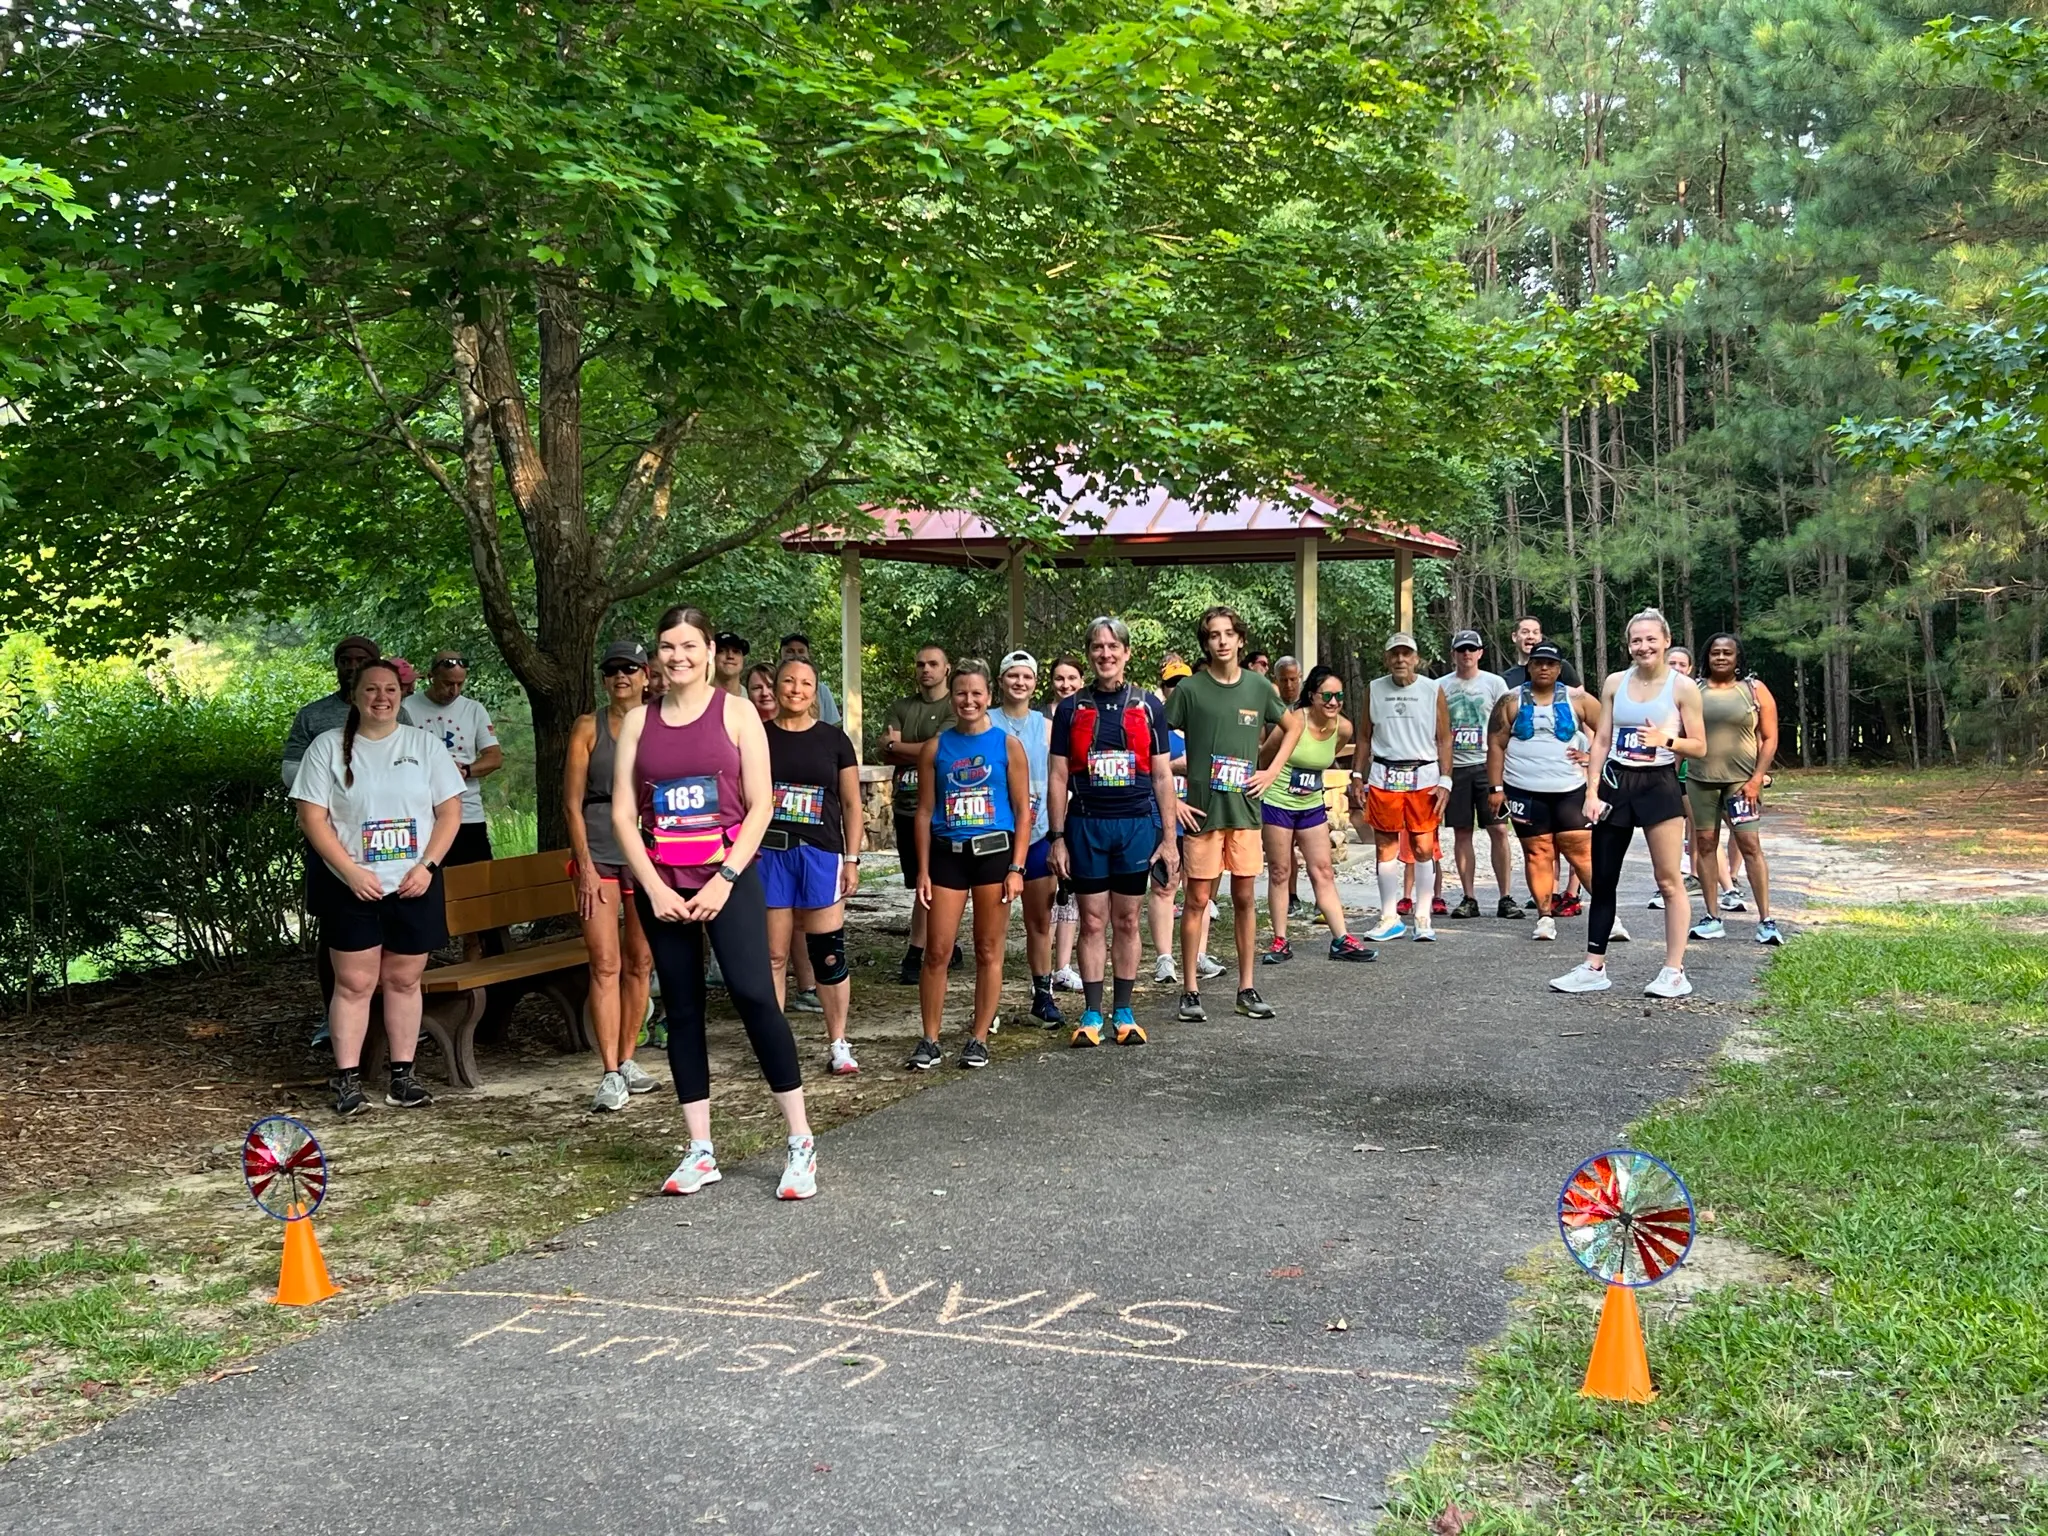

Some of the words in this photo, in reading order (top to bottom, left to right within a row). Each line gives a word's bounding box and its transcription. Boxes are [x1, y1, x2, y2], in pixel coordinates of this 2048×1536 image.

[1455, 731, 1479, 744] 420
[1093, 758, 1129, 778] 403
[1217, 764, 1246, 785] 416
[1387, 769, 1414, 785] 399
[1299, 772, 1316, 788] 174
[664, 785, 705, 811] 183
[781, 791, 813, 814] 411
[953, 796, 986, 817] 410
[1509, 799, 1525, 816] 182
[371, 829, 411, 851] 400
[696, 1267, 1238, 1348] START
[453, 1306, 888, 1390] Finish
